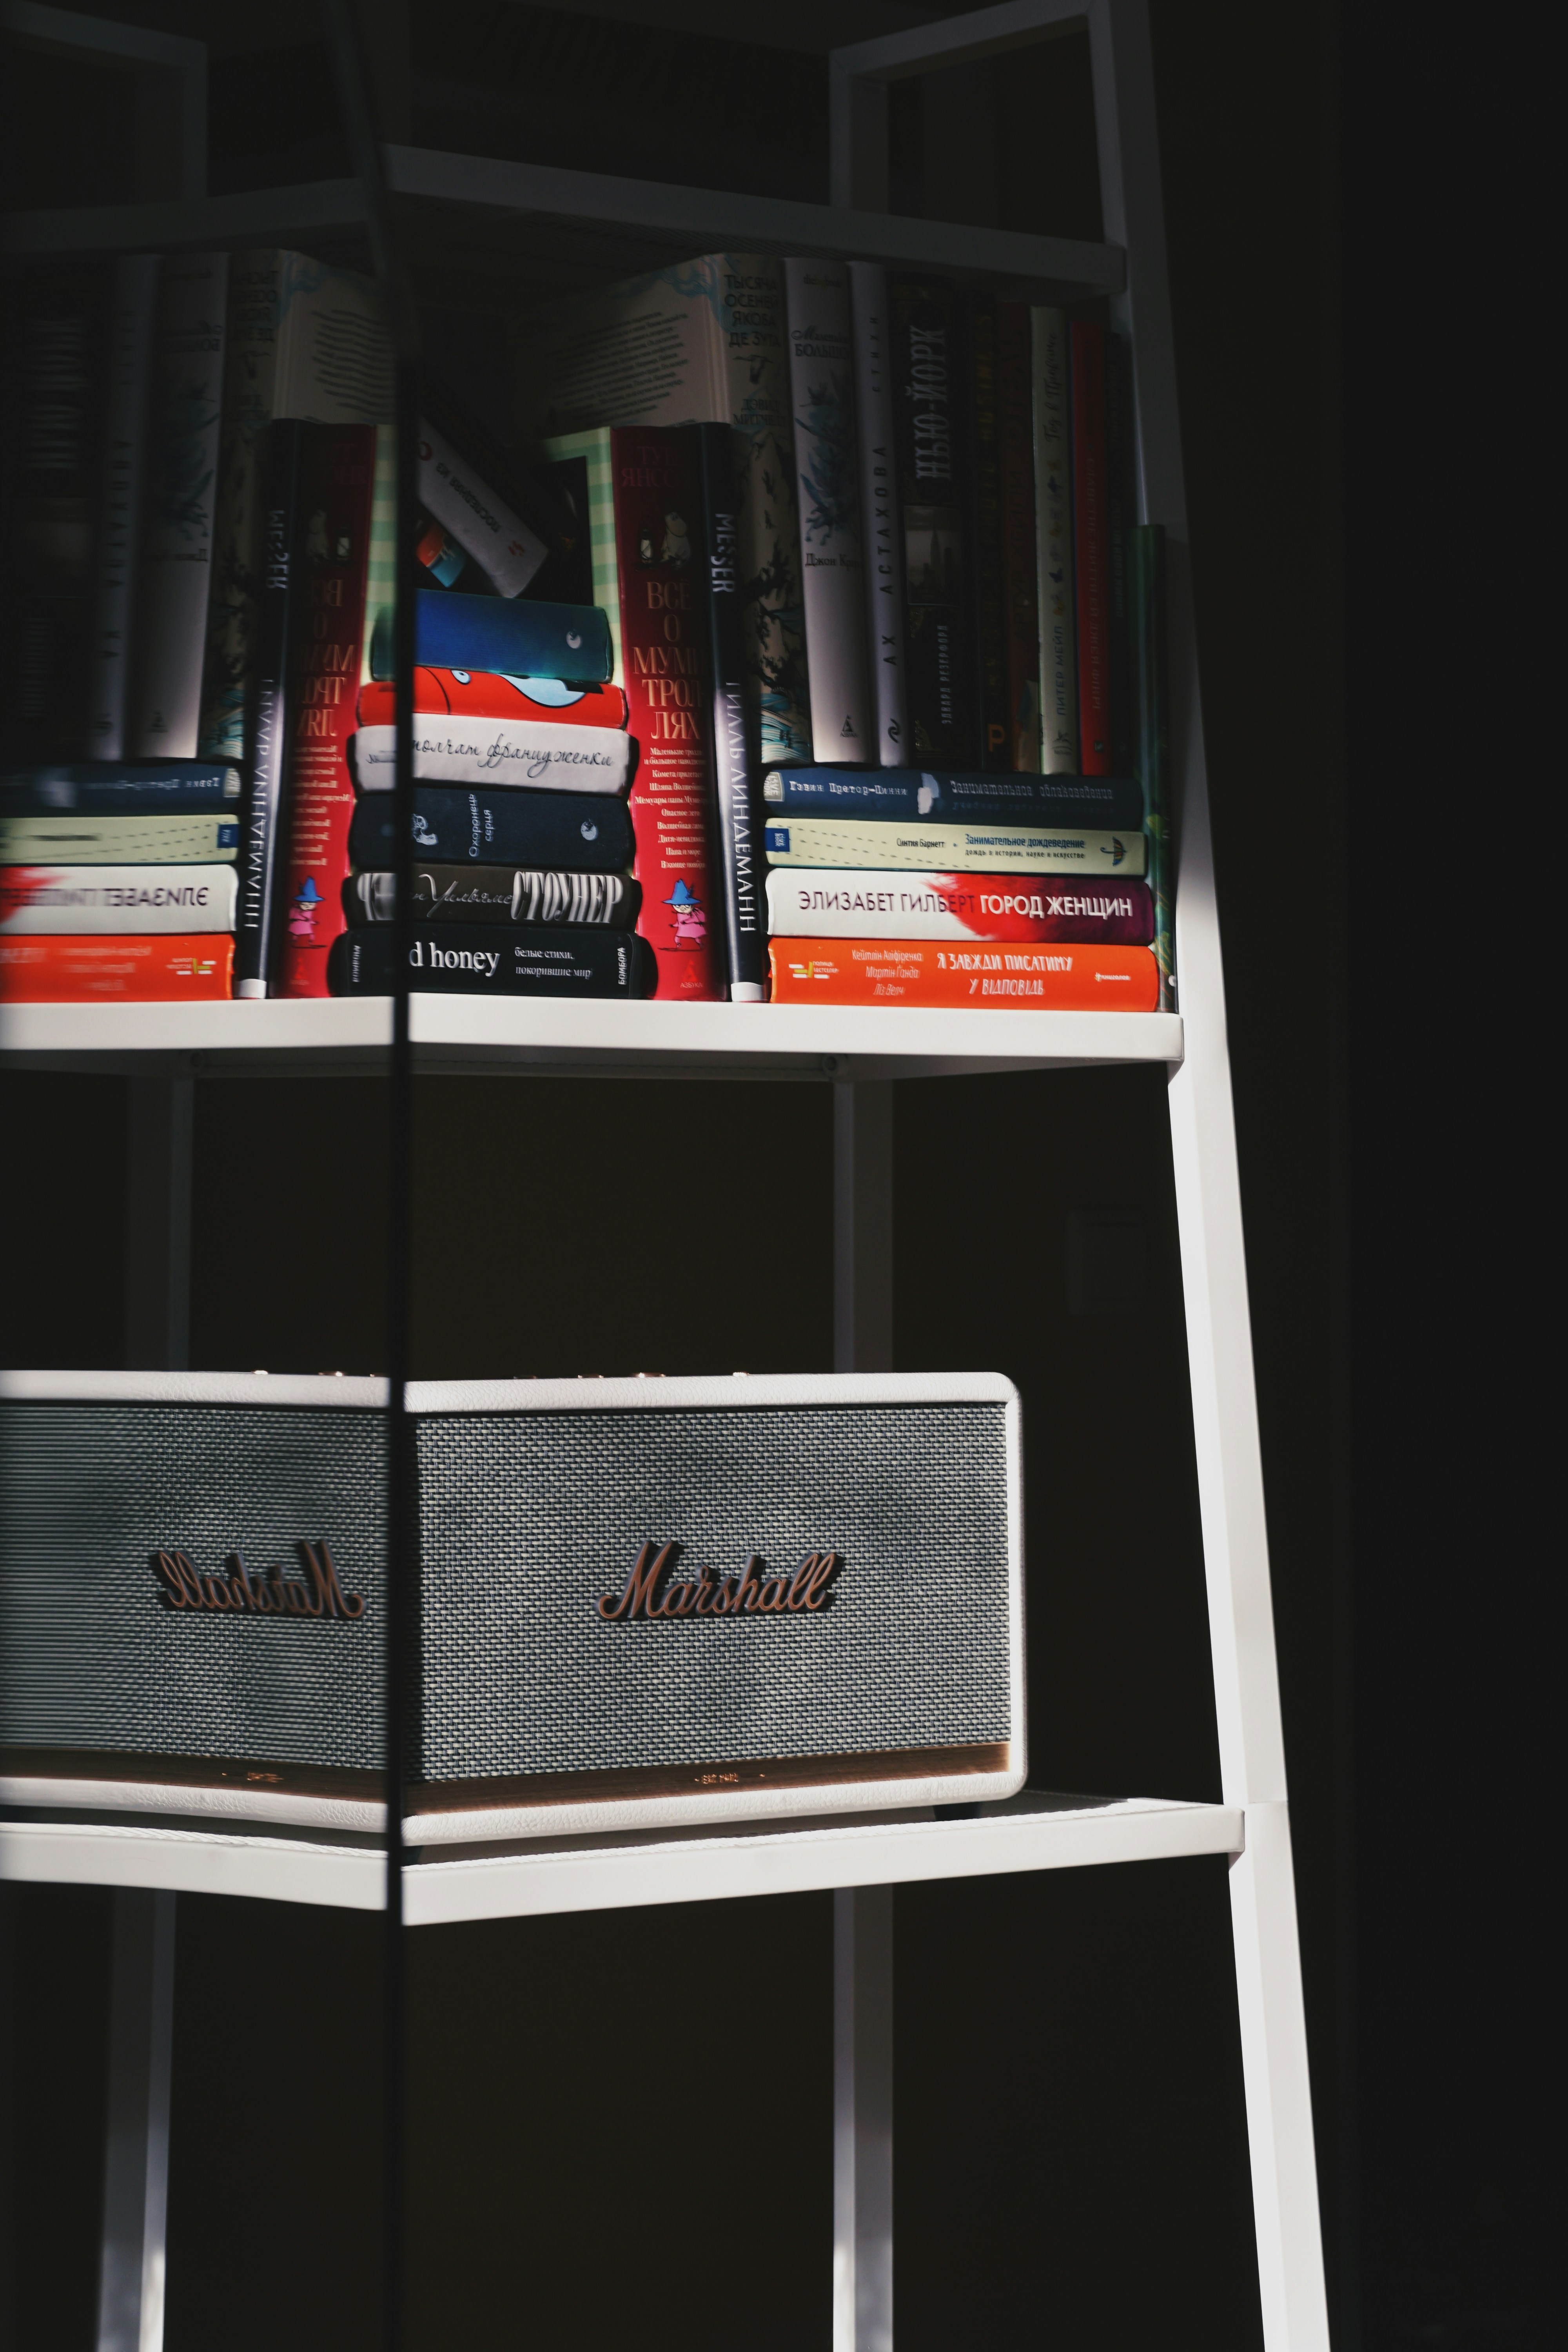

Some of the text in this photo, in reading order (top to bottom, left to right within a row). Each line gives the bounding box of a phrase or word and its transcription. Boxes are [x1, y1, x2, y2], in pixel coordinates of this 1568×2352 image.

[724, 275, 777, 290] ТЫСЯЧА
[725, 294, 778, 309] ОСЕНЕЙ
[732, 311, 776, 327] ЯКОБА
[729, 332, 749, 348] ДЕ
[795, 343, 850, 360] БОЛЬШО
[905, 324, 953, 481] НЬЮ-ЙОРК
[1044, 401, 1060, 414] в
[1044, 419, 1061, 443] Год
[449, 476, 503, 533] ПОСЛЕДНЯЯ
[710, 513, 737, 593] MESSER
[805, 553, 836, 566] Джон
[873, 446, 897, 666] АХ АСТАХОВА
[646, 578, 691, 610] ВСЁ
[664, 614, 681, 642] О
[1053, 625, 1066, 716] ПИТЕР МЕЙЛ
[941, 686, 953, 724] ЭДВАРД
[651, 711, 701, 740] ЛЯХ
[478, 733, 614, 778] француженки
[650, 757, 677, 765] большое
[789, 781, 908, 796] Гэвин Претор-Пинни
[950, 780, 1114, 800] Занимательное облаковедение
[635, 796, 666, 806] Мемуары
[726, 680, 757, 932] ТИЛЛЬ ЛИНДЕМАНН
[468, 794, 483, 857] Охоронець
[484, 810, 495, 842] серця
[657, 821, 691, 829] Волшебная
[658, 835, 706, 843] Дитя-невидимка
[897, 838, 945, 848] Синтия Барнетт
[965, 834, 1085, 848] Занимательное дождеведение
[666, 847, 682, 855] Папа
[510, 871, 624, 923] СТОУНЕР
[798, 891, 975, 913] ЭЛИЗАБЕТ ГИЛБЕРТ
[980, 895, 1133, 920] ГОРОД ЖЕНЩИН
[428, 942, 501, 977] honey
[515, 947, 543, 958] белые
[852, 949, 882, 961] Кейтлін
[618, 947, 627, 985] БОМБОРА
[937, 953, 1073, 972] Я ЗАВЖДИ ПИСАТИМУ
[515, 965, 591, 980] покорившие мир
[866, 965, 895, 981] Мартін
[873, 984, 906, 996] Ліз Велч
[969, 978, 1045, 996] У ВІДПОВІДЬ
[598, 1540, 834, 1619] Marshall
